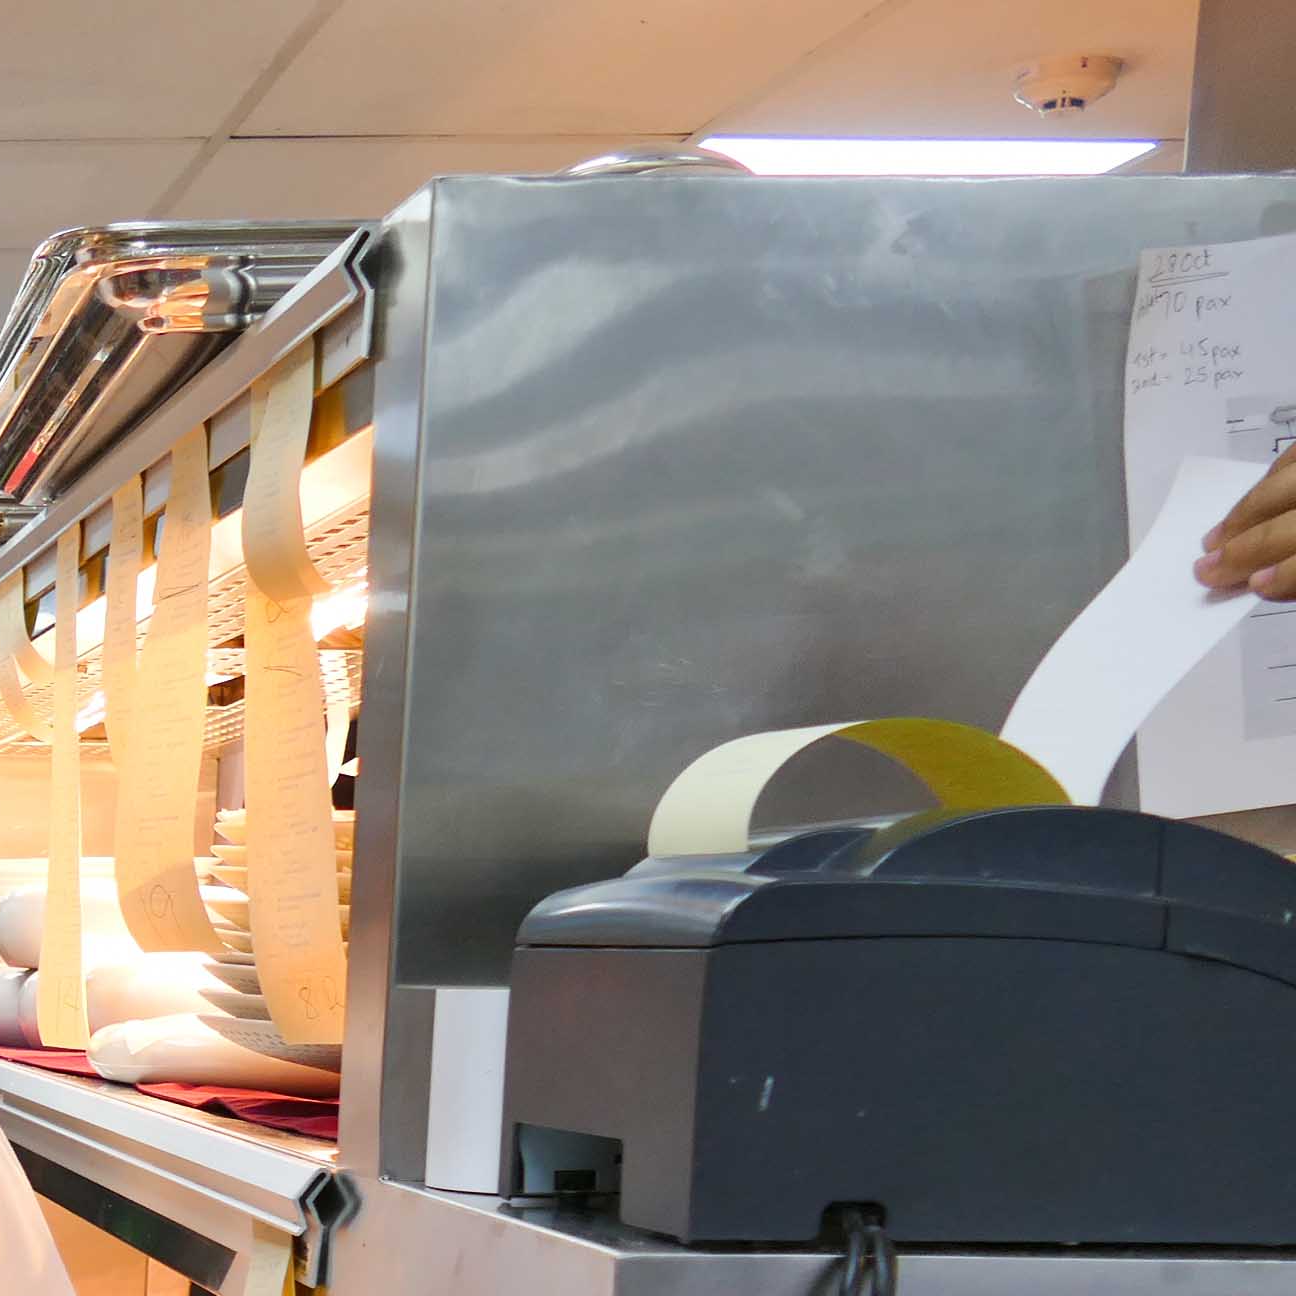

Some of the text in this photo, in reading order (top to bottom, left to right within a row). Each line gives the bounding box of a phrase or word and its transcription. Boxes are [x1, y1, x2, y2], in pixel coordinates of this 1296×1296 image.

[1196, 295, 1232, 320] pax
[1211, 344, 1242, 366] pax
[1213, 369, 1244, 390] pax
